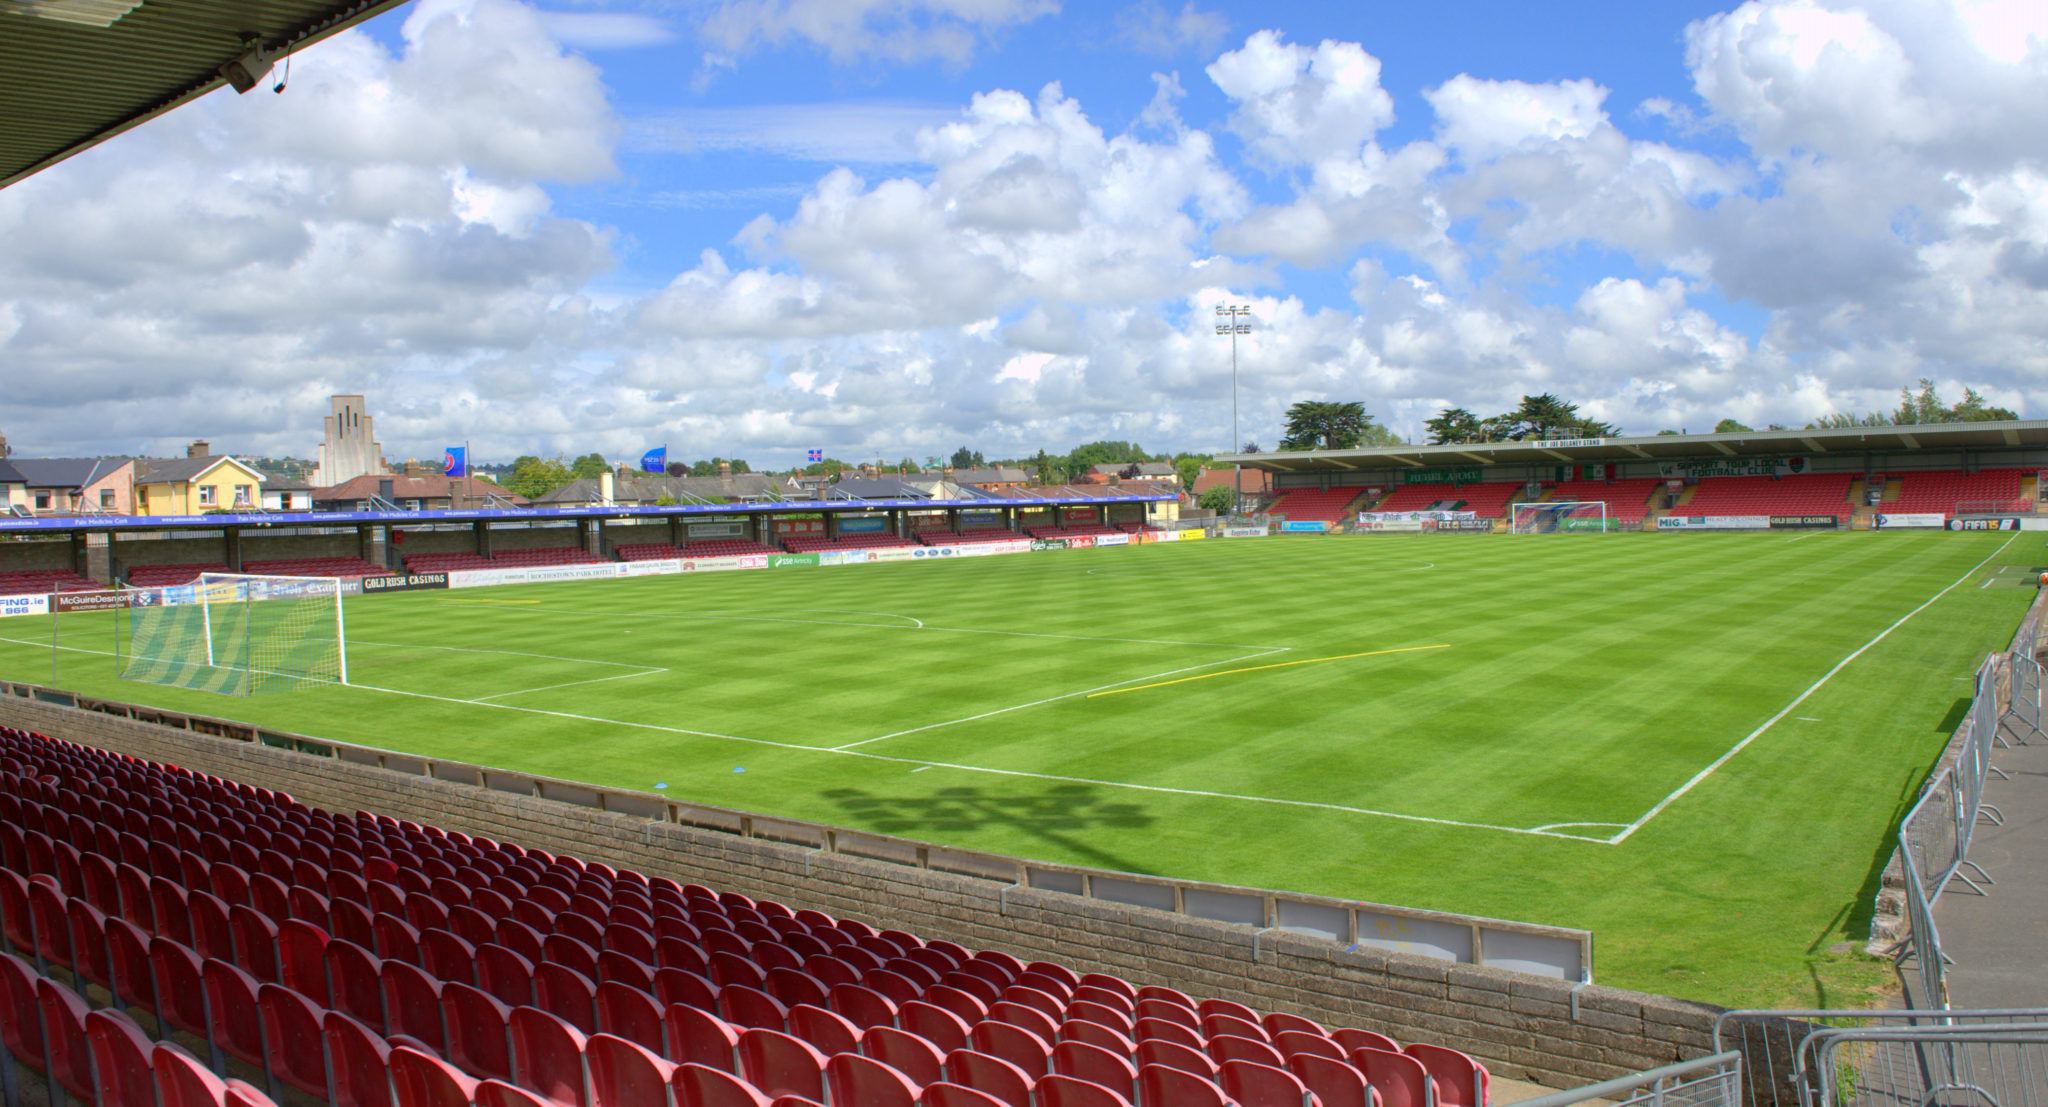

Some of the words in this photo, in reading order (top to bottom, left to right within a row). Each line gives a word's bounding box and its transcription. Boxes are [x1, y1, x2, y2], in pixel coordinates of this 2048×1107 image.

[1692, 468, 1744, 477] FOOTBALL
[1659, 518, 1680, 527] MIG
[1965, 520, 1987, 529] FIFA
[1987, 520, 1999, 529] 15
[530, 570, 575, 580] ROCHESTOWN
[576, 569, 592, 578] PARK
[593, 568, 612, 576] HOTEL
[364, 578, 384, 589] GOLD
[386, 577, 406, 587] RUSH
[408, 574, 445, 585] CASINOS
[306, 581, 358, 593] Examner
[5, 606, 29, 614] 966
